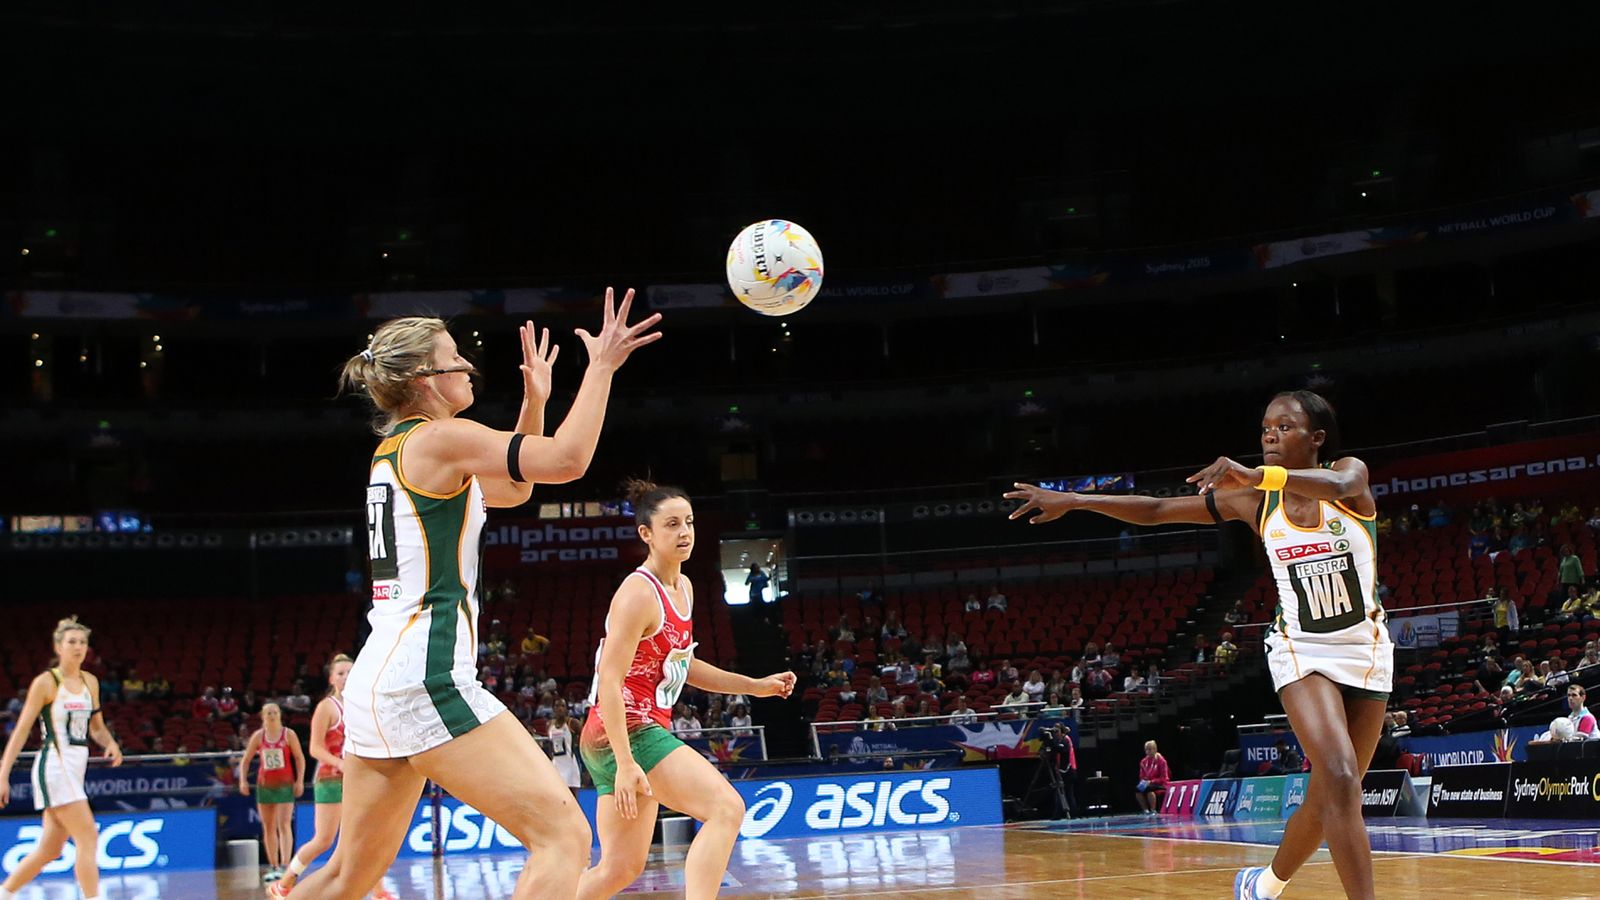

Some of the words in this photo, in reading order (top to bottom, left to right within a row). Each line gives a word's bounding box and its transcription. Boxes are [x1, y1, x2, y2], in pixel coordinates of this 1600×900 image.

[1438, 220, 1488, 233] NETBALL
[1489, 211, 1532, 227] WORLD
[1533, 207, 1556, 220] CUP
[1373, 455, 1600, 497] phonesarena.
[485, 524, 637, 547] allphone
[520, 547, 619, 562] arena
[1278, 544, 1330, 559] SPAR
[1297, 559, 1347, 577] TELSTRA
[1300, 571, 1353, 620] WA
[1468, 750, 1484, 764] CUP
[86, 779, 149, 794] WORLD
[152, 777, 188, 791] CUP
[408, 803, 527, 853] asi
